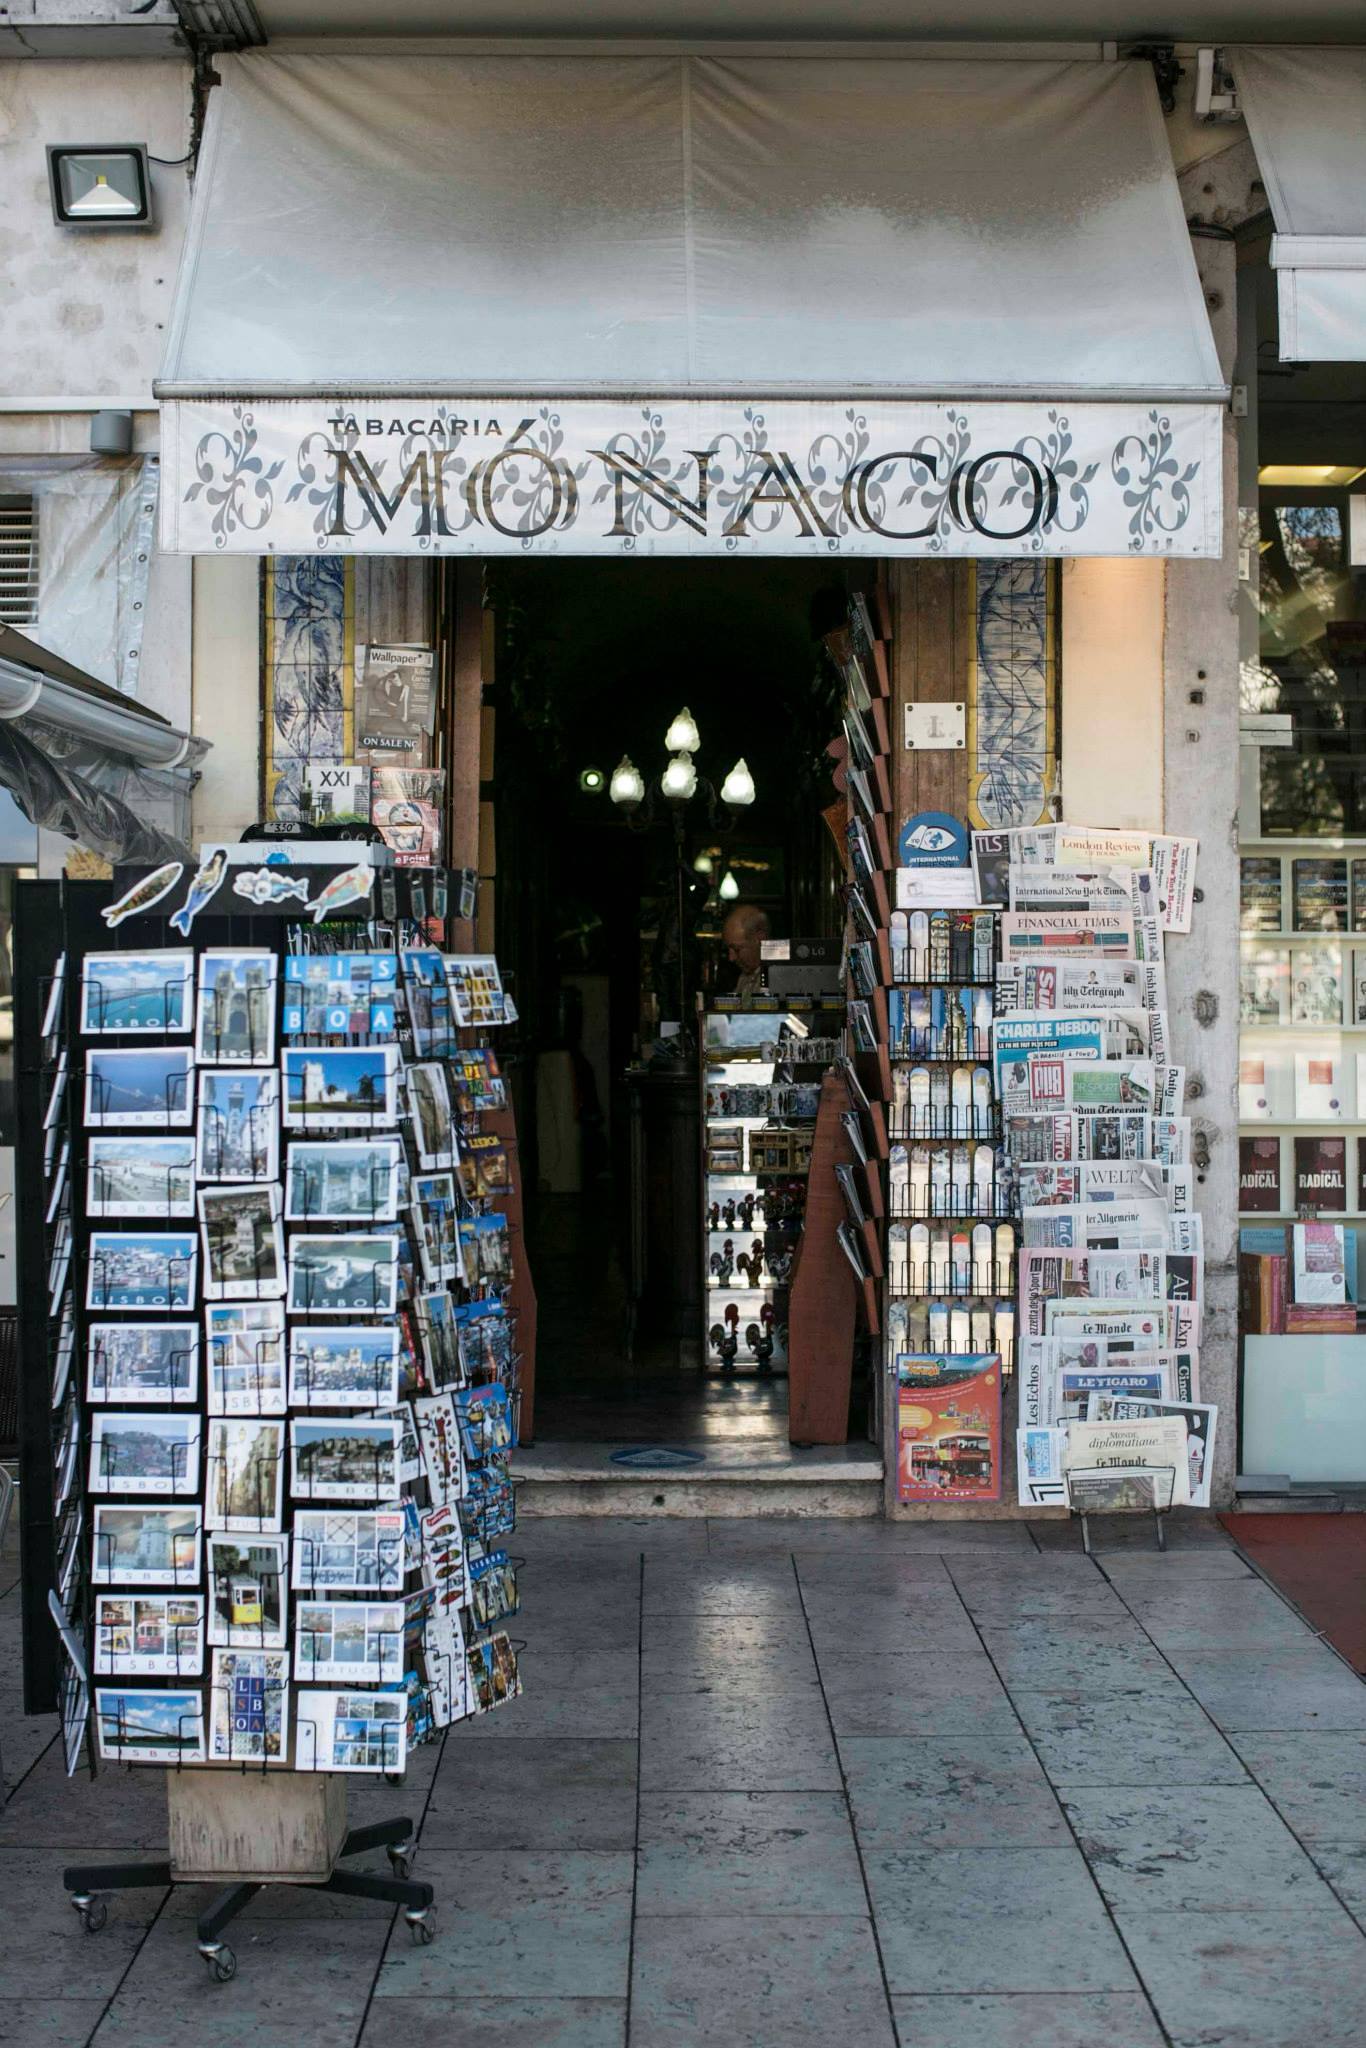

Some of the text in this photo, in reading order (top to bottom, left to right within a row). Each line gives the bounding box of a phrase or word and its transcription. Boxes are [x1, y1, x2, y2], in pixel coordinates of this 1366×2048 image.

[328, 419, 502, 436] TABACARIA
[324, 419, 1059, 540] MÓNACO
[363, 737, 379, 746] ON
[380, 739, 403, 747] SALE
[320, 771, 351, 787] XXI
[976, 836, 1003, 853] TLS
[1061, 839, 1141, 852] London Review
[1015, 886, 1064, 896] International
[1065, 887, 1083, 896] New
[1083, 888, 1103, 898] York
[1018, 917, 1120, 928] FINANCIAL TIMES
[812, 947, 826, 956] LG
[1146, 967, 1156, 989] Irish
[1080, 985, 1125, 998] Telegraph
[89, 1019, 179, 1029] LISBOA
[997, 1021, 1099, 1038] CHARLIE HEBDO
[1152, 1013, 1163, 1043] DAILY
[1164, 1068, 1179, 1098] Daily
[1090, 1170, 1138, 1184] WELT
[1240, 1174, 1278, 1188] ADICAL
[1299, 1174, 1344, 1188] RADICAL
[1174, 1184, 1186, 1205] EL
[1097, 1211, 1140, 1225] Allgemeine
[1029, 1271, 1041, 1292] Sport
[95, 1295, 184, 1304] LISBOA
[296, 1299, 387, 1308] LISBOA
[1082, 1321, 1132, 1334] Le Monde
[1026, 1365, 1040, 1402] Echos
[1078, 1377, 1148, 1387] LE FIGARO
[1178, 1365, 1190, 1402] Cinco
[1026, 1404, 1039, 1426] Les
[1108, 1456, 1147, 1467] Monde
[97, 1481, 187, 1489] LISBOA
[297, 1486, 395, 1495] LISBOA
[95, 1572, 194, 1581] LISBOA
[99, 1660, 198, 1670] LISBOA
